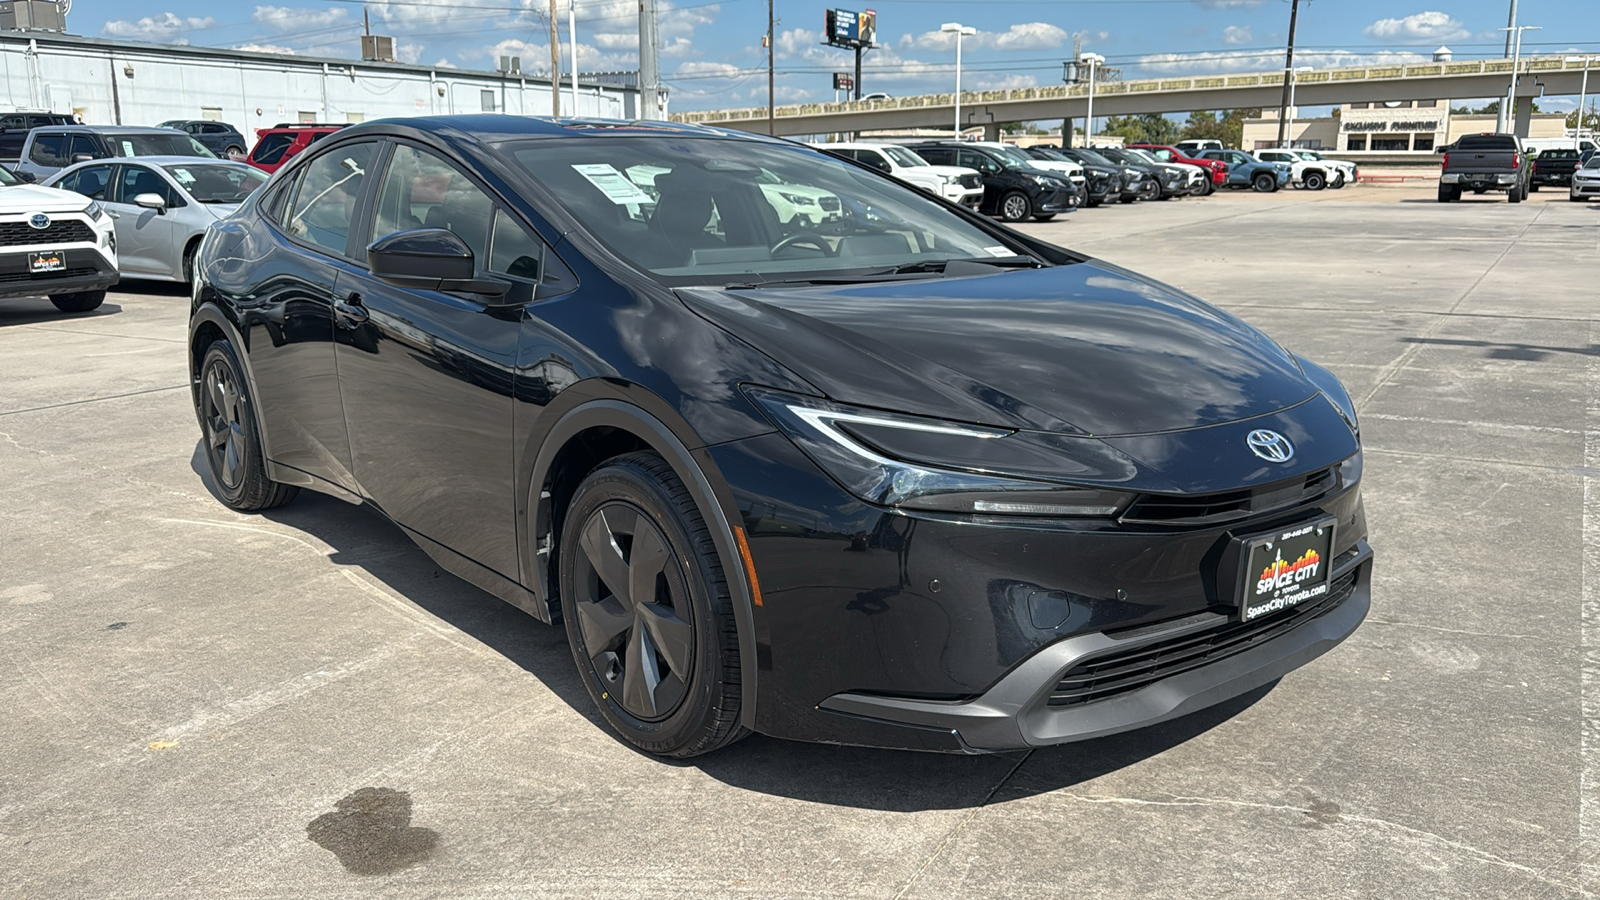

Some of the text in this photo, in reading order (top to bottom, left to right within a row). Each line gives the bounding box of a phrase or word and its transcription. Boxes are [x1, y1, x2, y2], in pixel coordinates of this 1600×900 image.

[1343, 121, 1438, 131] EXCLUSIVE FURNITURE
[1256, 562, 1319, 594] SPACE CITY
[1282, 584, 1299, 594] TOYOTA
[1247, 585, 1326, 618] SpaceCityToyota.com
